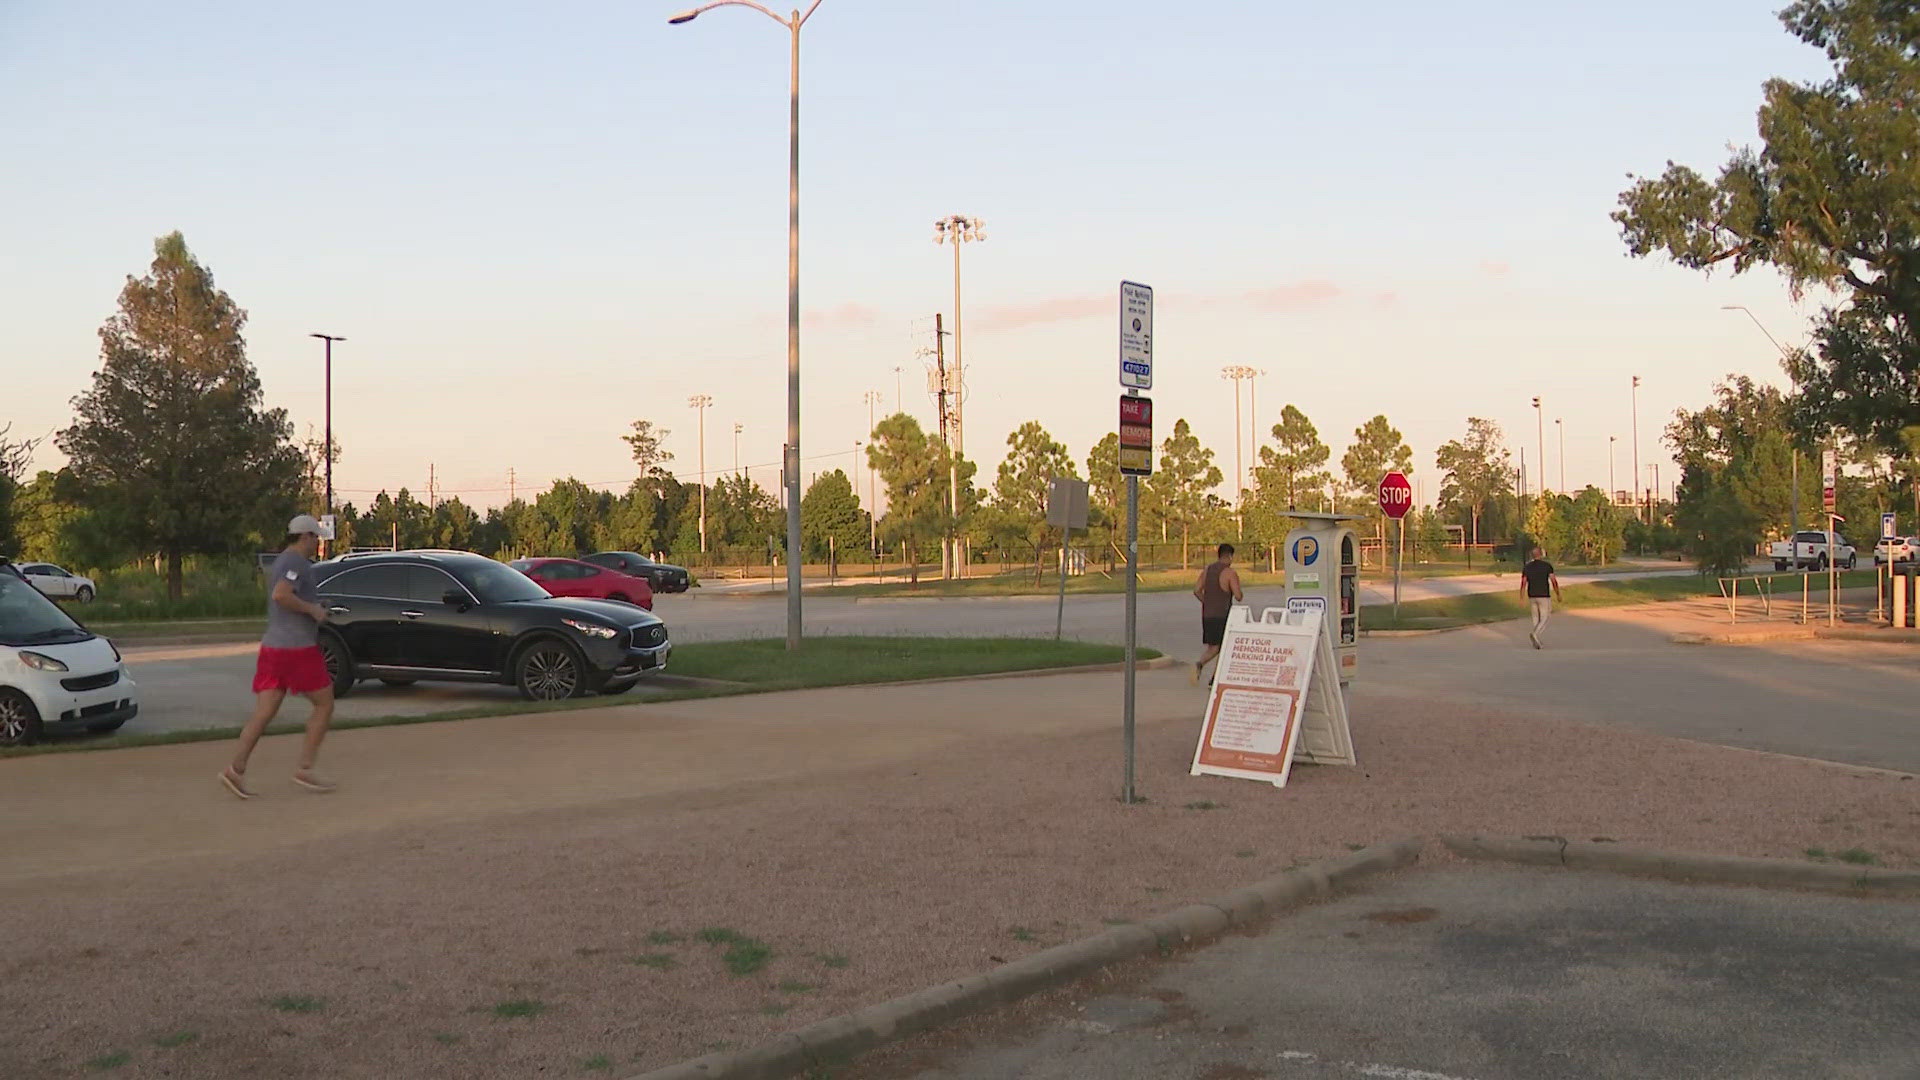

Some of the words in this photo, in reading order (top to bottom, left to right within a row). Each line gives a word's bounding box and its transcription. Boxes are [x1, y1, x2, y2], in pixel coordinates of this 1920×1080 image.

[1122, 403, 1139, 414] TAKE
[1121, 426, 1151, 439] REMOVE
[1381, 486, 1410, 504] STOP
[1291, 600, 1302, 608] Paid
[1303, 600, 1322, 609] Parking
[1234, 637, 1249, 645] GET
[1251, 638, 1272, 646] YOUR
[1233, 645, 1272, 654] MEMORIAL
[1273, 647, 1294, 656] PARK
[1231, 652, 1264, 661] PARKING
[1265, 655, 1287, 664] PASS!
